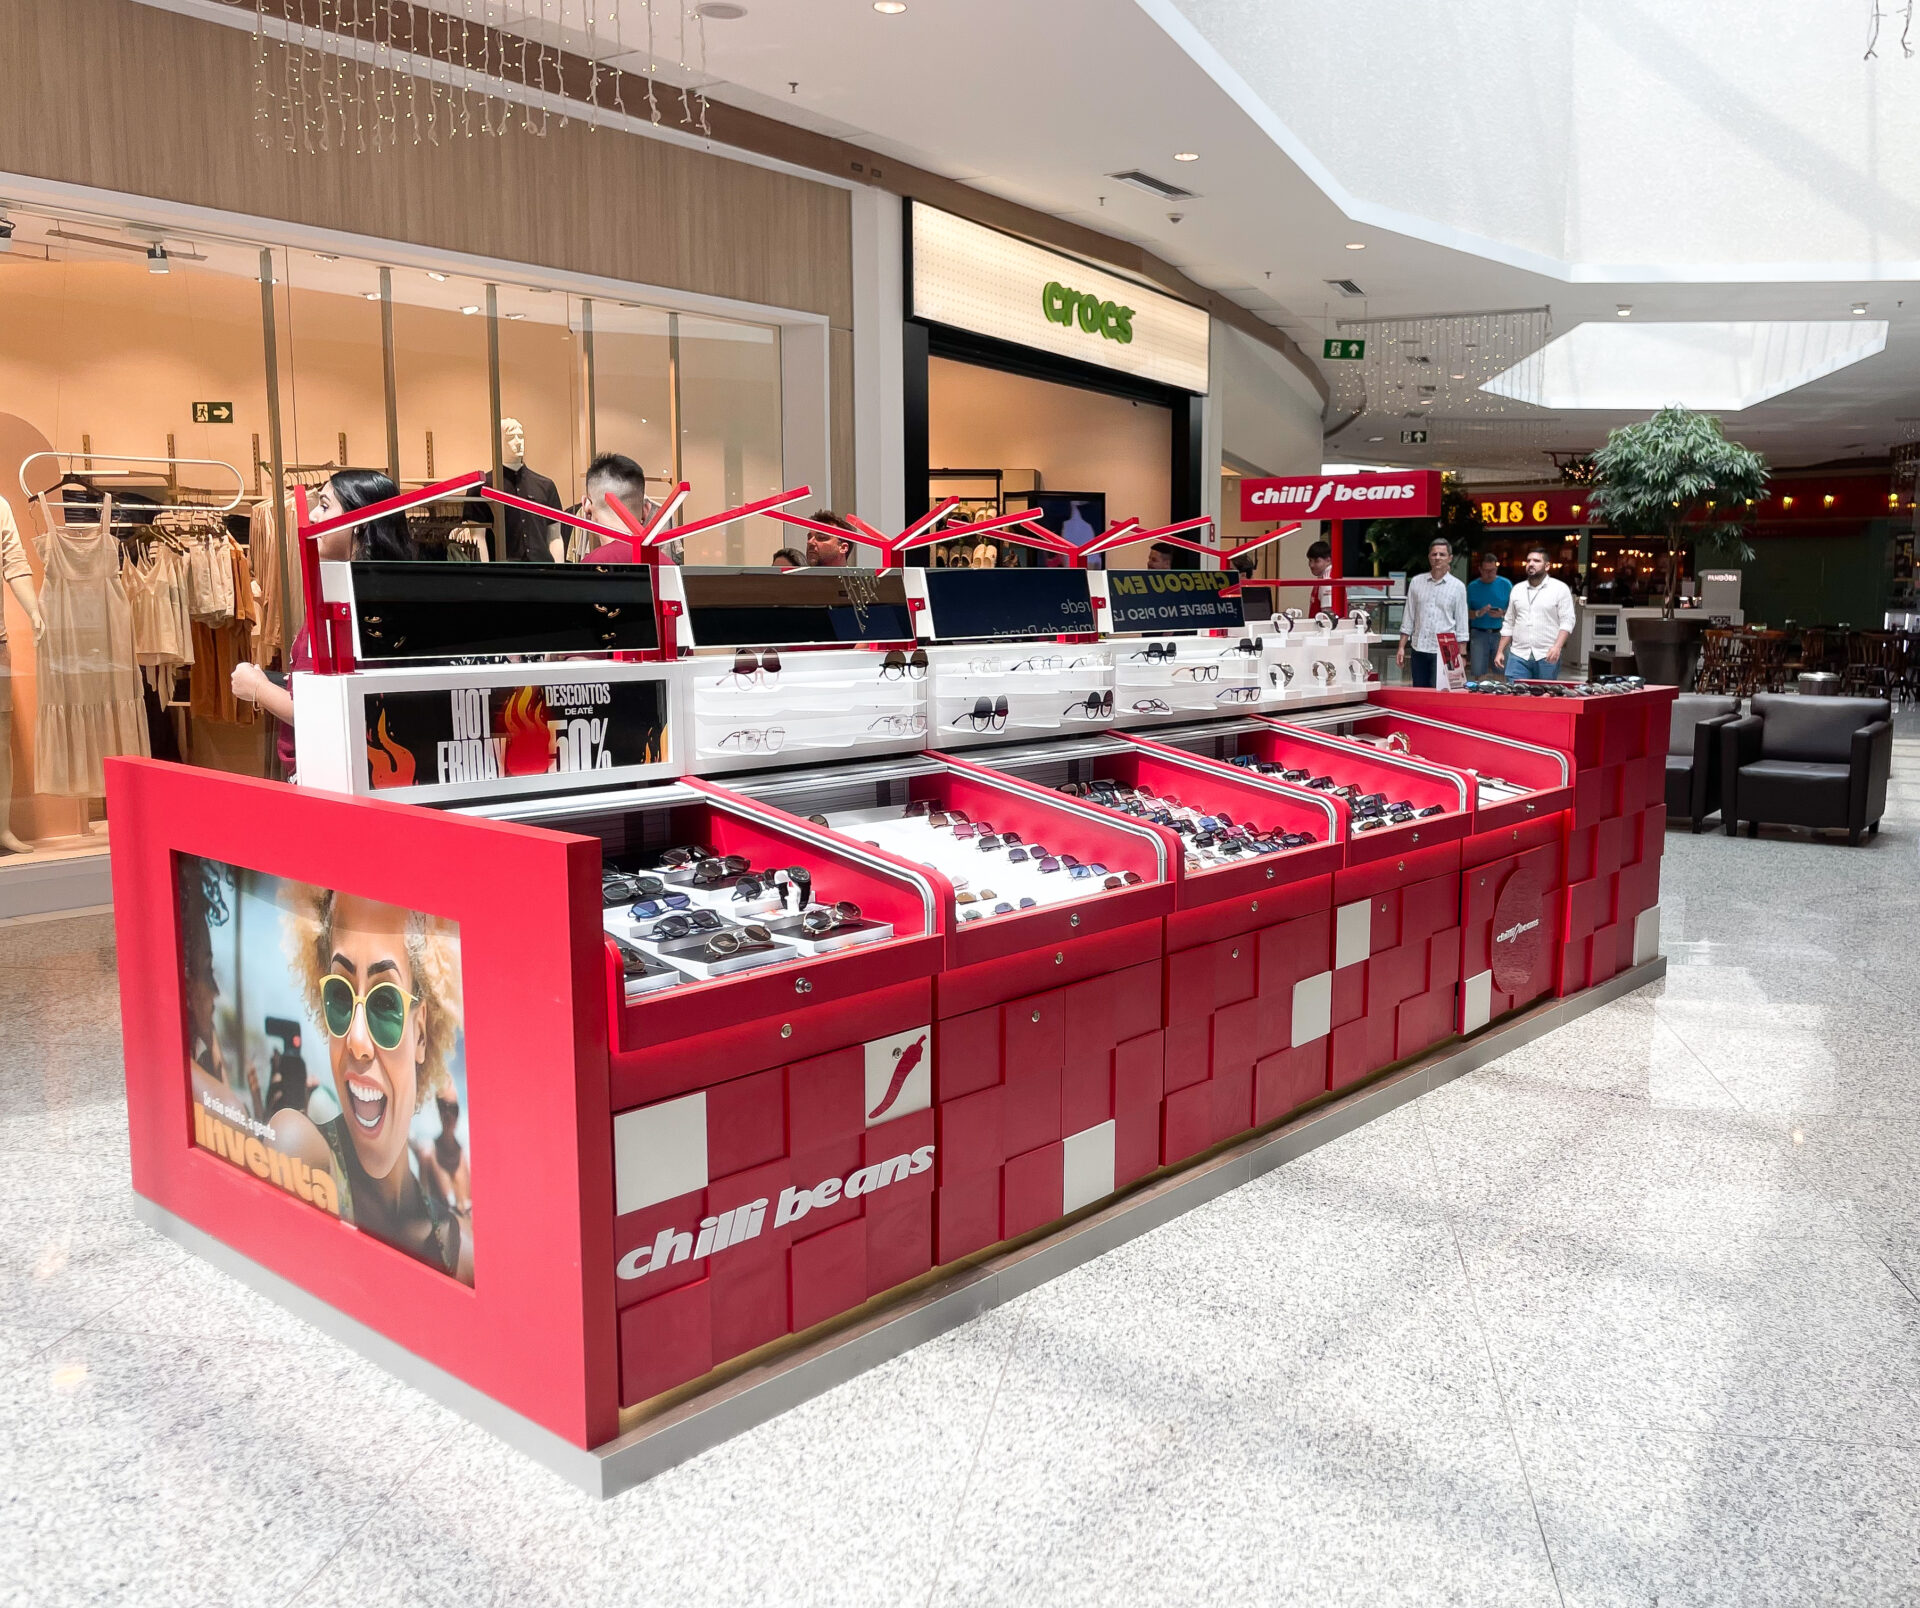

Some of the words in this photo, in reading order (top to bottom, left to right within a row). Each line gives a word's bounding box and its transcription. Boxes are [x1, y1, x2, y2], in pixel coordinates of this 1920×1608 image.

[1043, 281, 1136, 344] crocs
[1251, 485, 1313, 505] chilli
[1334, 484, 1416, 501] beans
[1472, 501, 1524, 523] RIS
[1532, 500, 1548, 522] 6
[451, 688, 491, 740] HOT
[545, 683, 611, 707] DESCONTOS
[565, 707, 576, 715] DE
[577, 705, 593, 715] ATÉ
[437, 737, 506, 784] FRIDAY
[547, 717, 612, 773] 50%
[616, 1197, 769, 1280] chilli
[774, 1145, 936, 1229] beans
